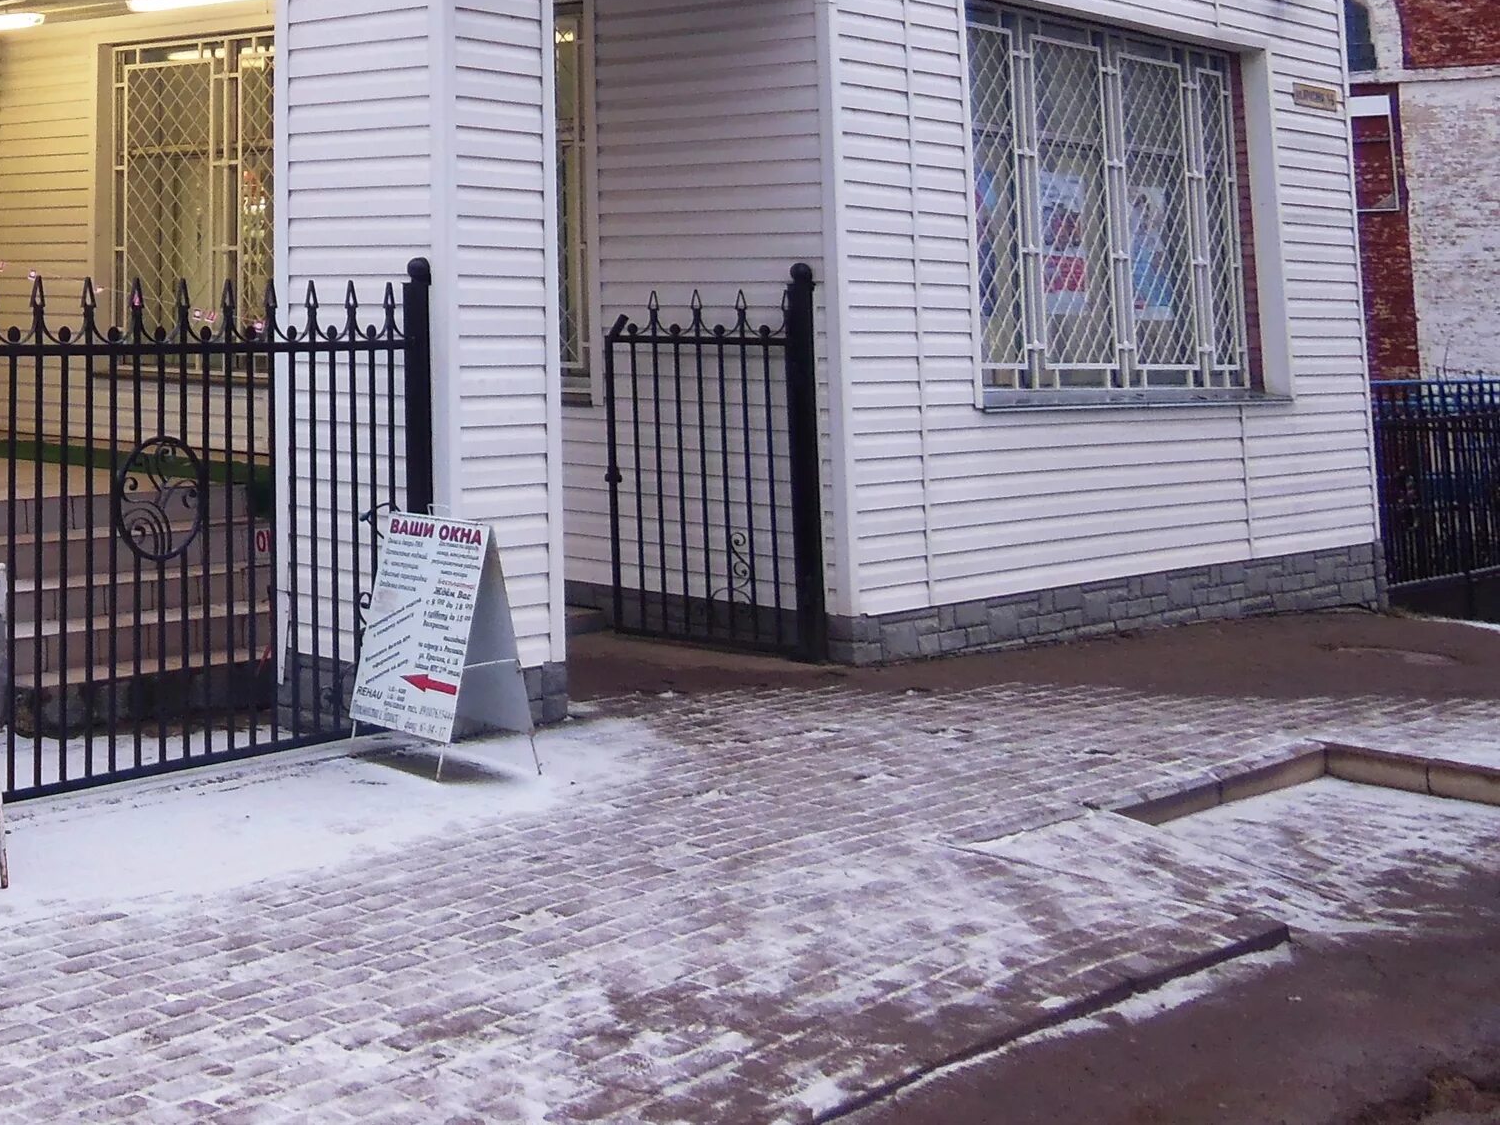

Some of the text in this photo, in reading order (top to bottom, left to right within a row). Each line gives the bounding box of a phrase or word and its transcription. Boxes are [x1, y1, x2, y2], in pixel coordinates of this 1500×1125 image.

[390, 518, 435, 538] ВАШИ
[439, 524, 482, 546] ОКНА
[356, 685, 383, 699] REHAU
